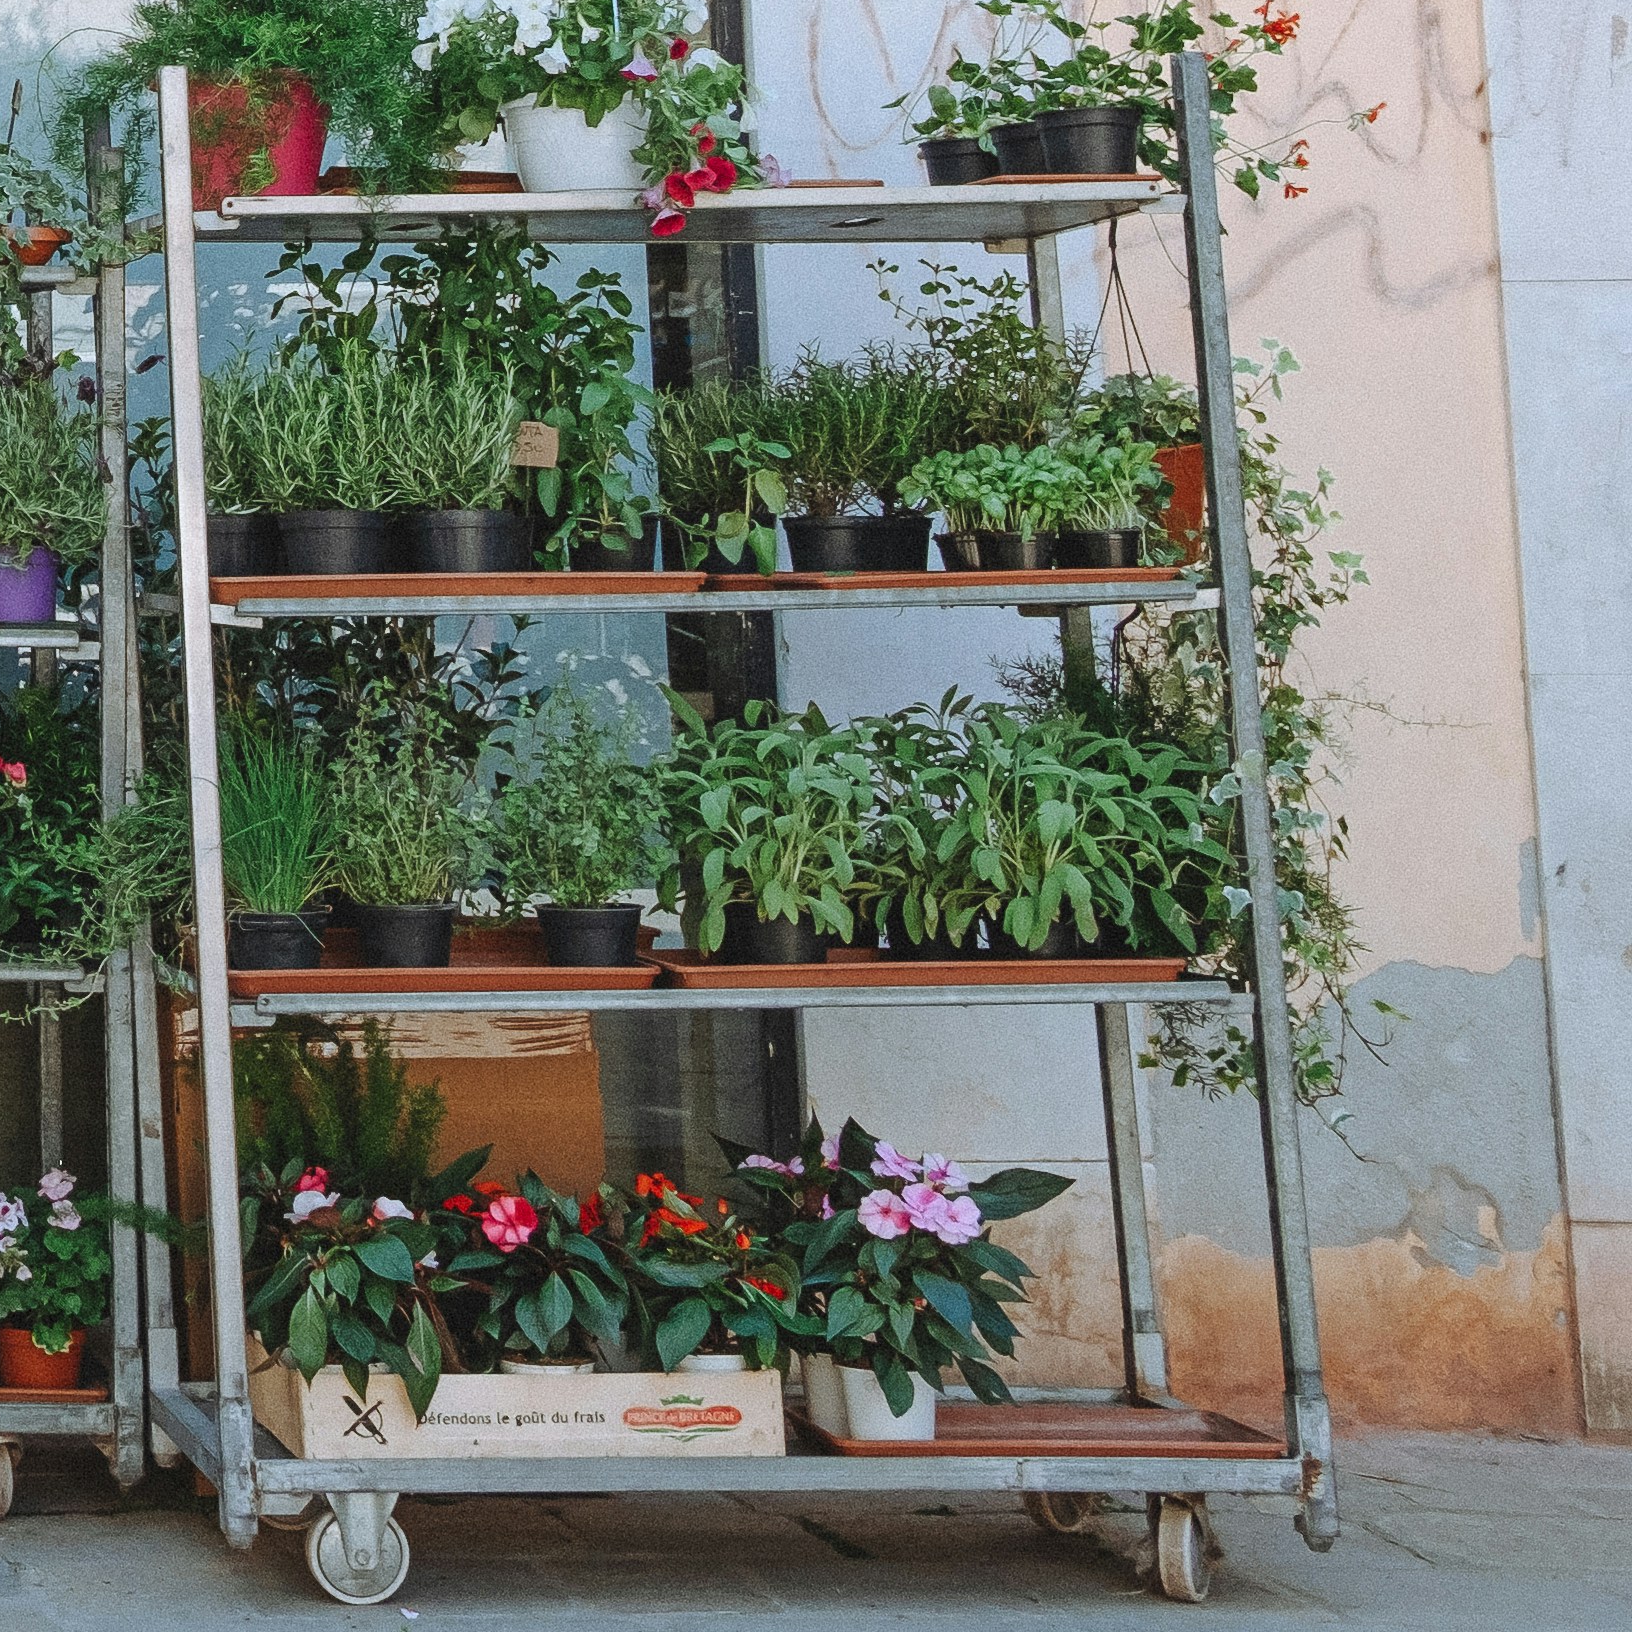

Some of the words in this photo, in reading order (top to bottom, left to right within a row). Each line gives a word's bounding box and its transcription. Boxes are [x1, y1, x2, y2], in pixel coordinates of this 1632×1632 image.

[496, 1412, 510, 1424] le
[515, 1411, 545, 1426] goût
[551, 1411, 569, 1424] du
[574, 1411, 606, 1423] frais
